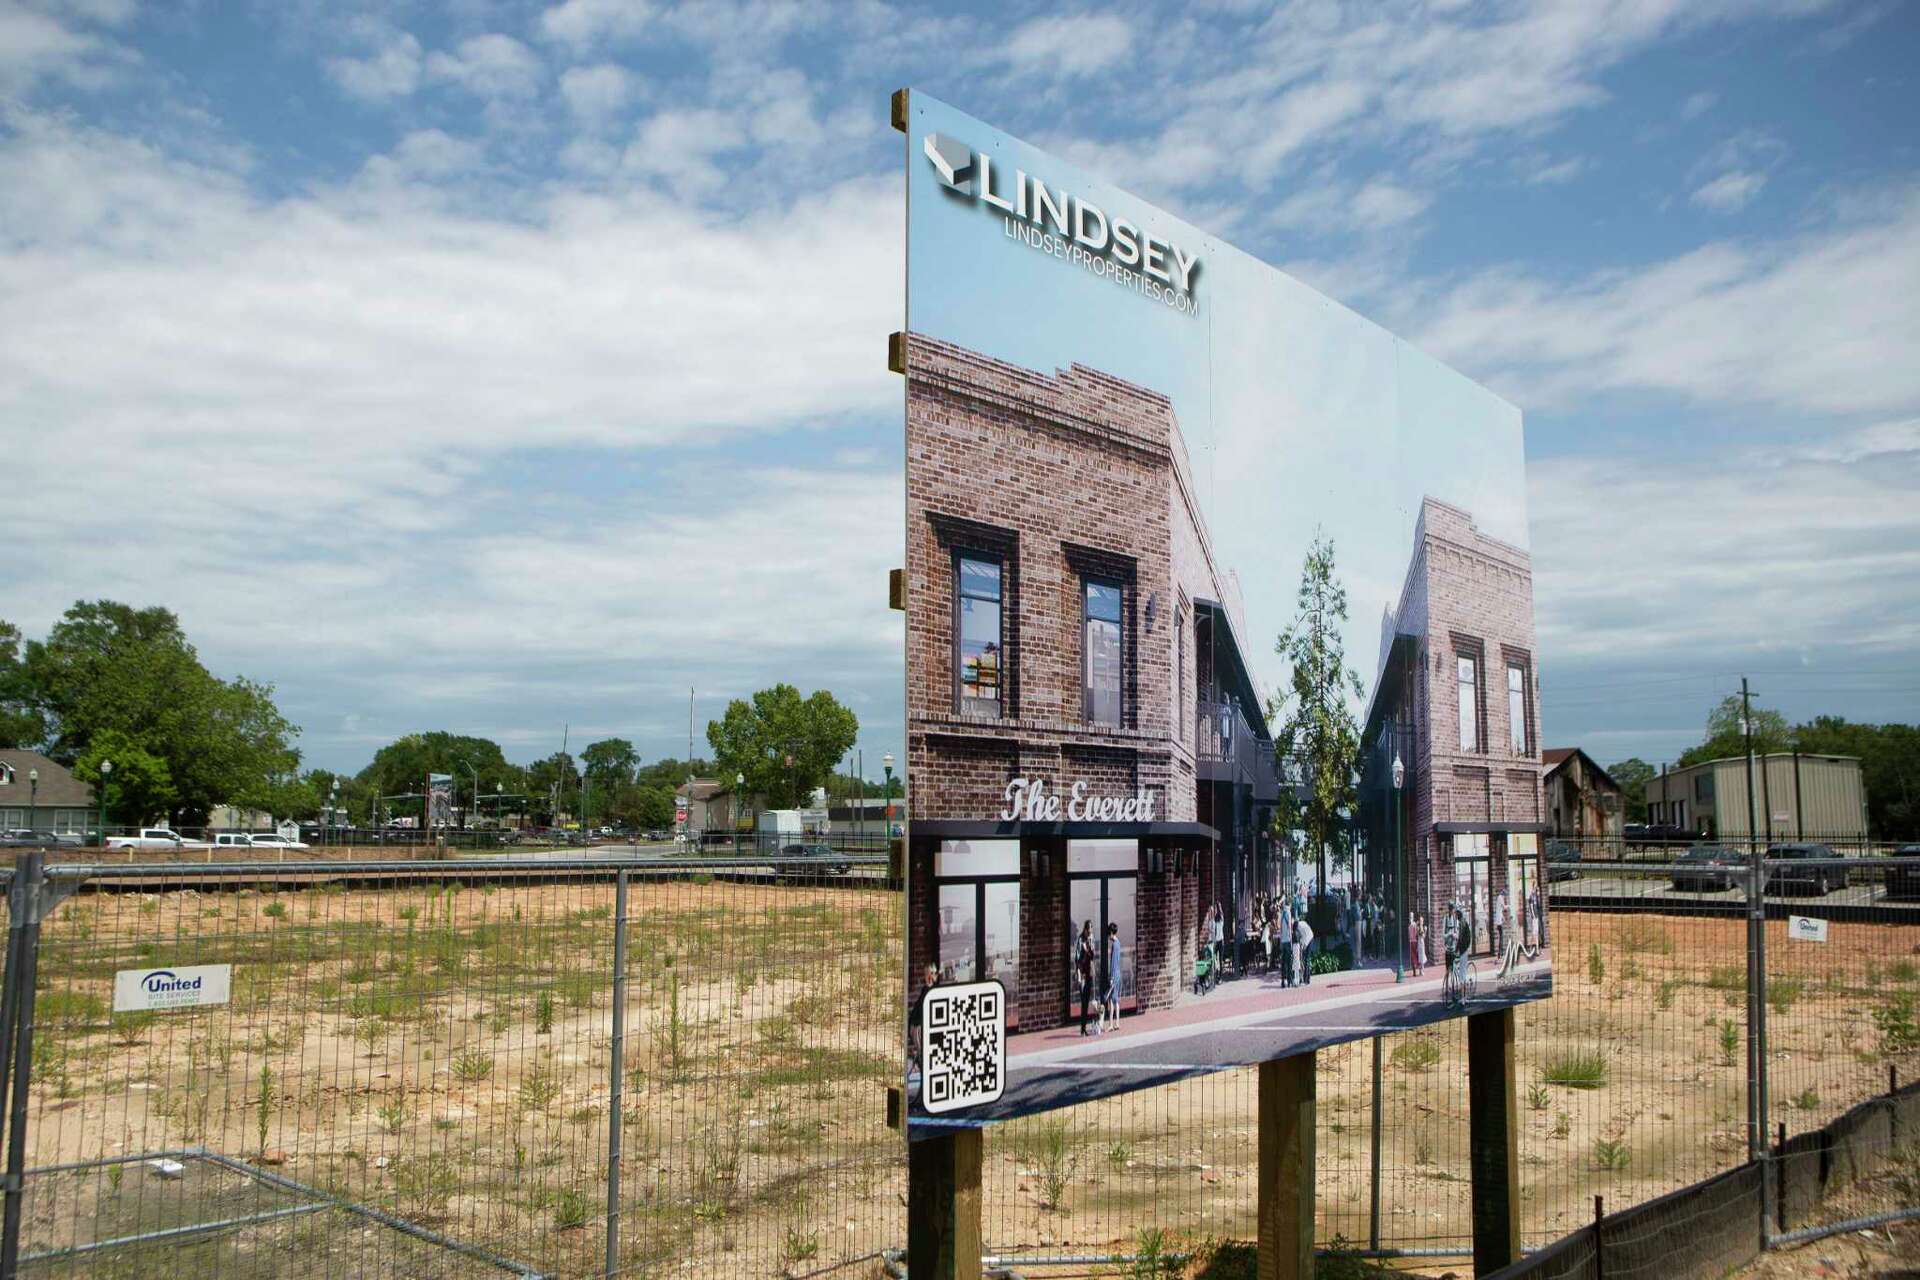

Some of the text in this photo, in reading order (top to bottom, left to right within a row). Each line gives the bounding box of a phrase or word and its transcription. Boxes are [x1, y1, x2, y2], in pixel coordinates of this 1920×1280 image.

[979, 152, 1200, 291] LINDSEY
[1004, 216, 1199, 317] LINDSEYPROPERTIES.COM
[1001, 777, 1156, 822] The Everett
[148, 976, 202, 993] United
